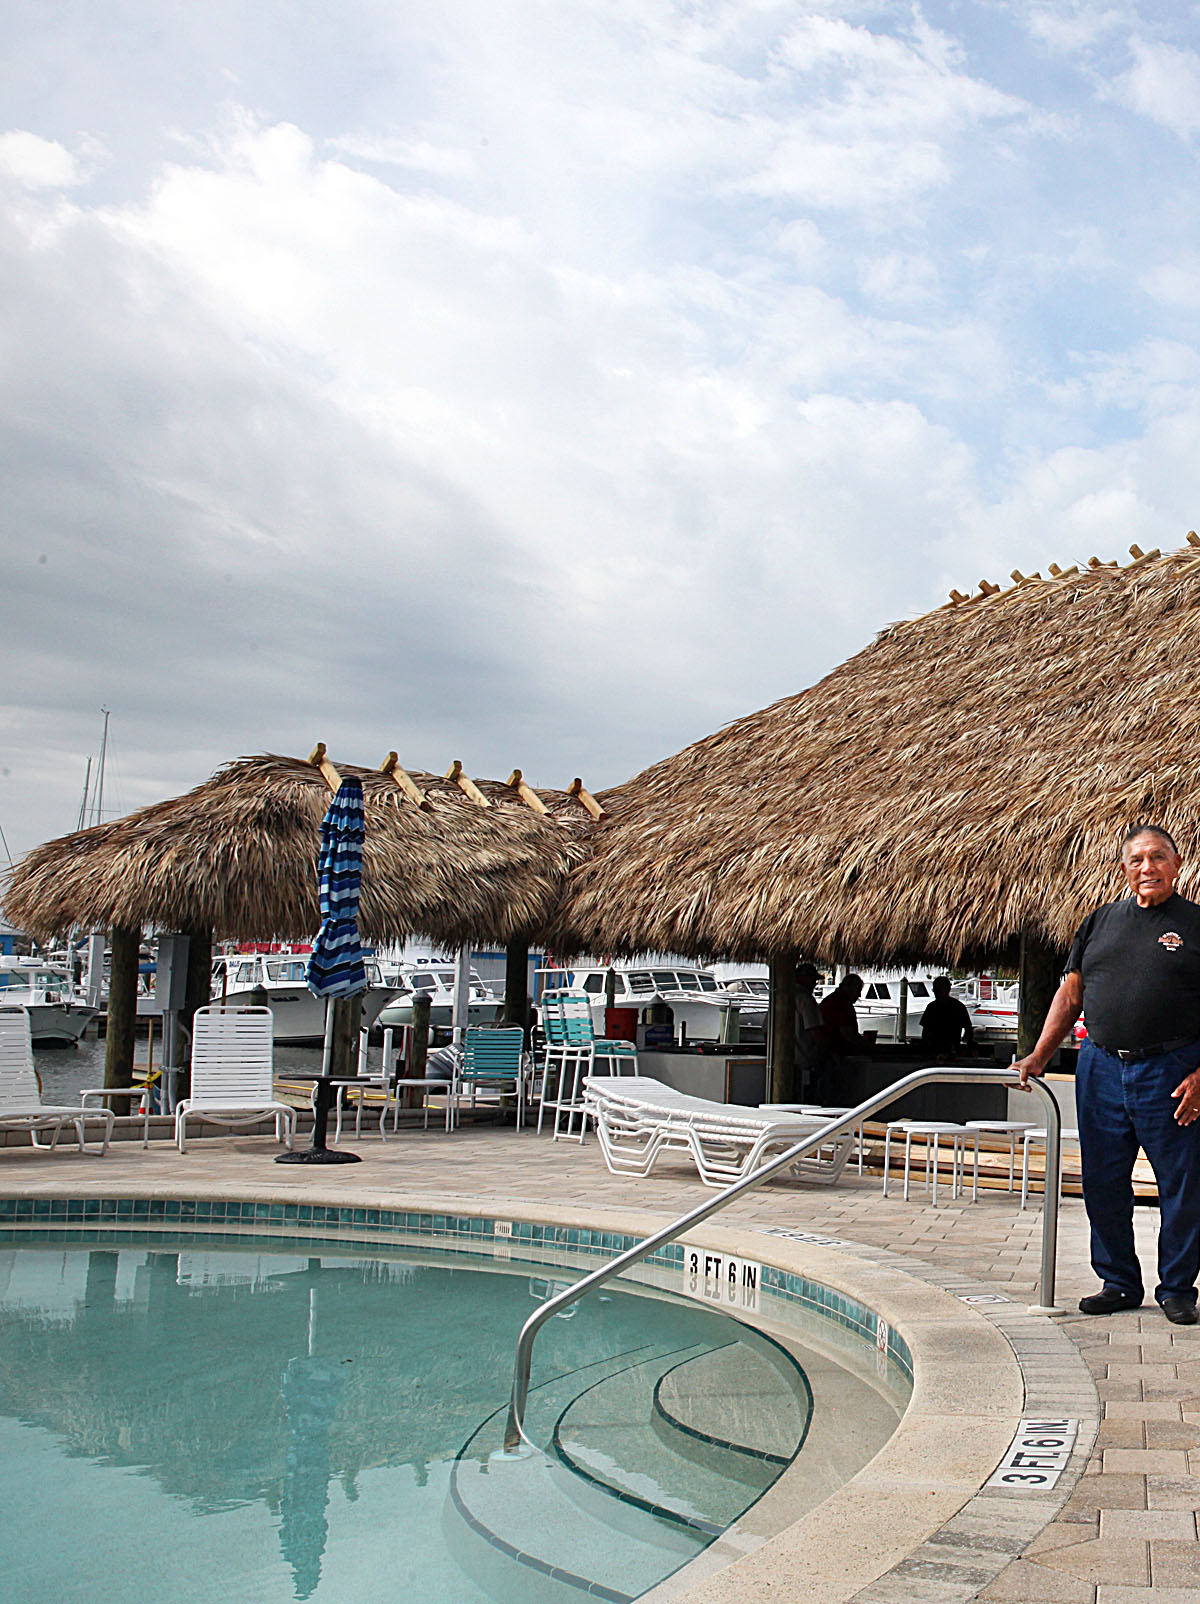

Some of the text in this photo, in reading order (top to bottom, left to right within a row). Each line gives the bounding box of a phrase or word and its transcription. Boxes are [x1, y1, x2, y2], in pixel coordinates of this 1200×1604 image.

[690, 1252, 757, 1289] 3 FT 6 IN
[1021, 1439, 1065, 1448] 6
[1001, 1473, 1048, 1485] 3
